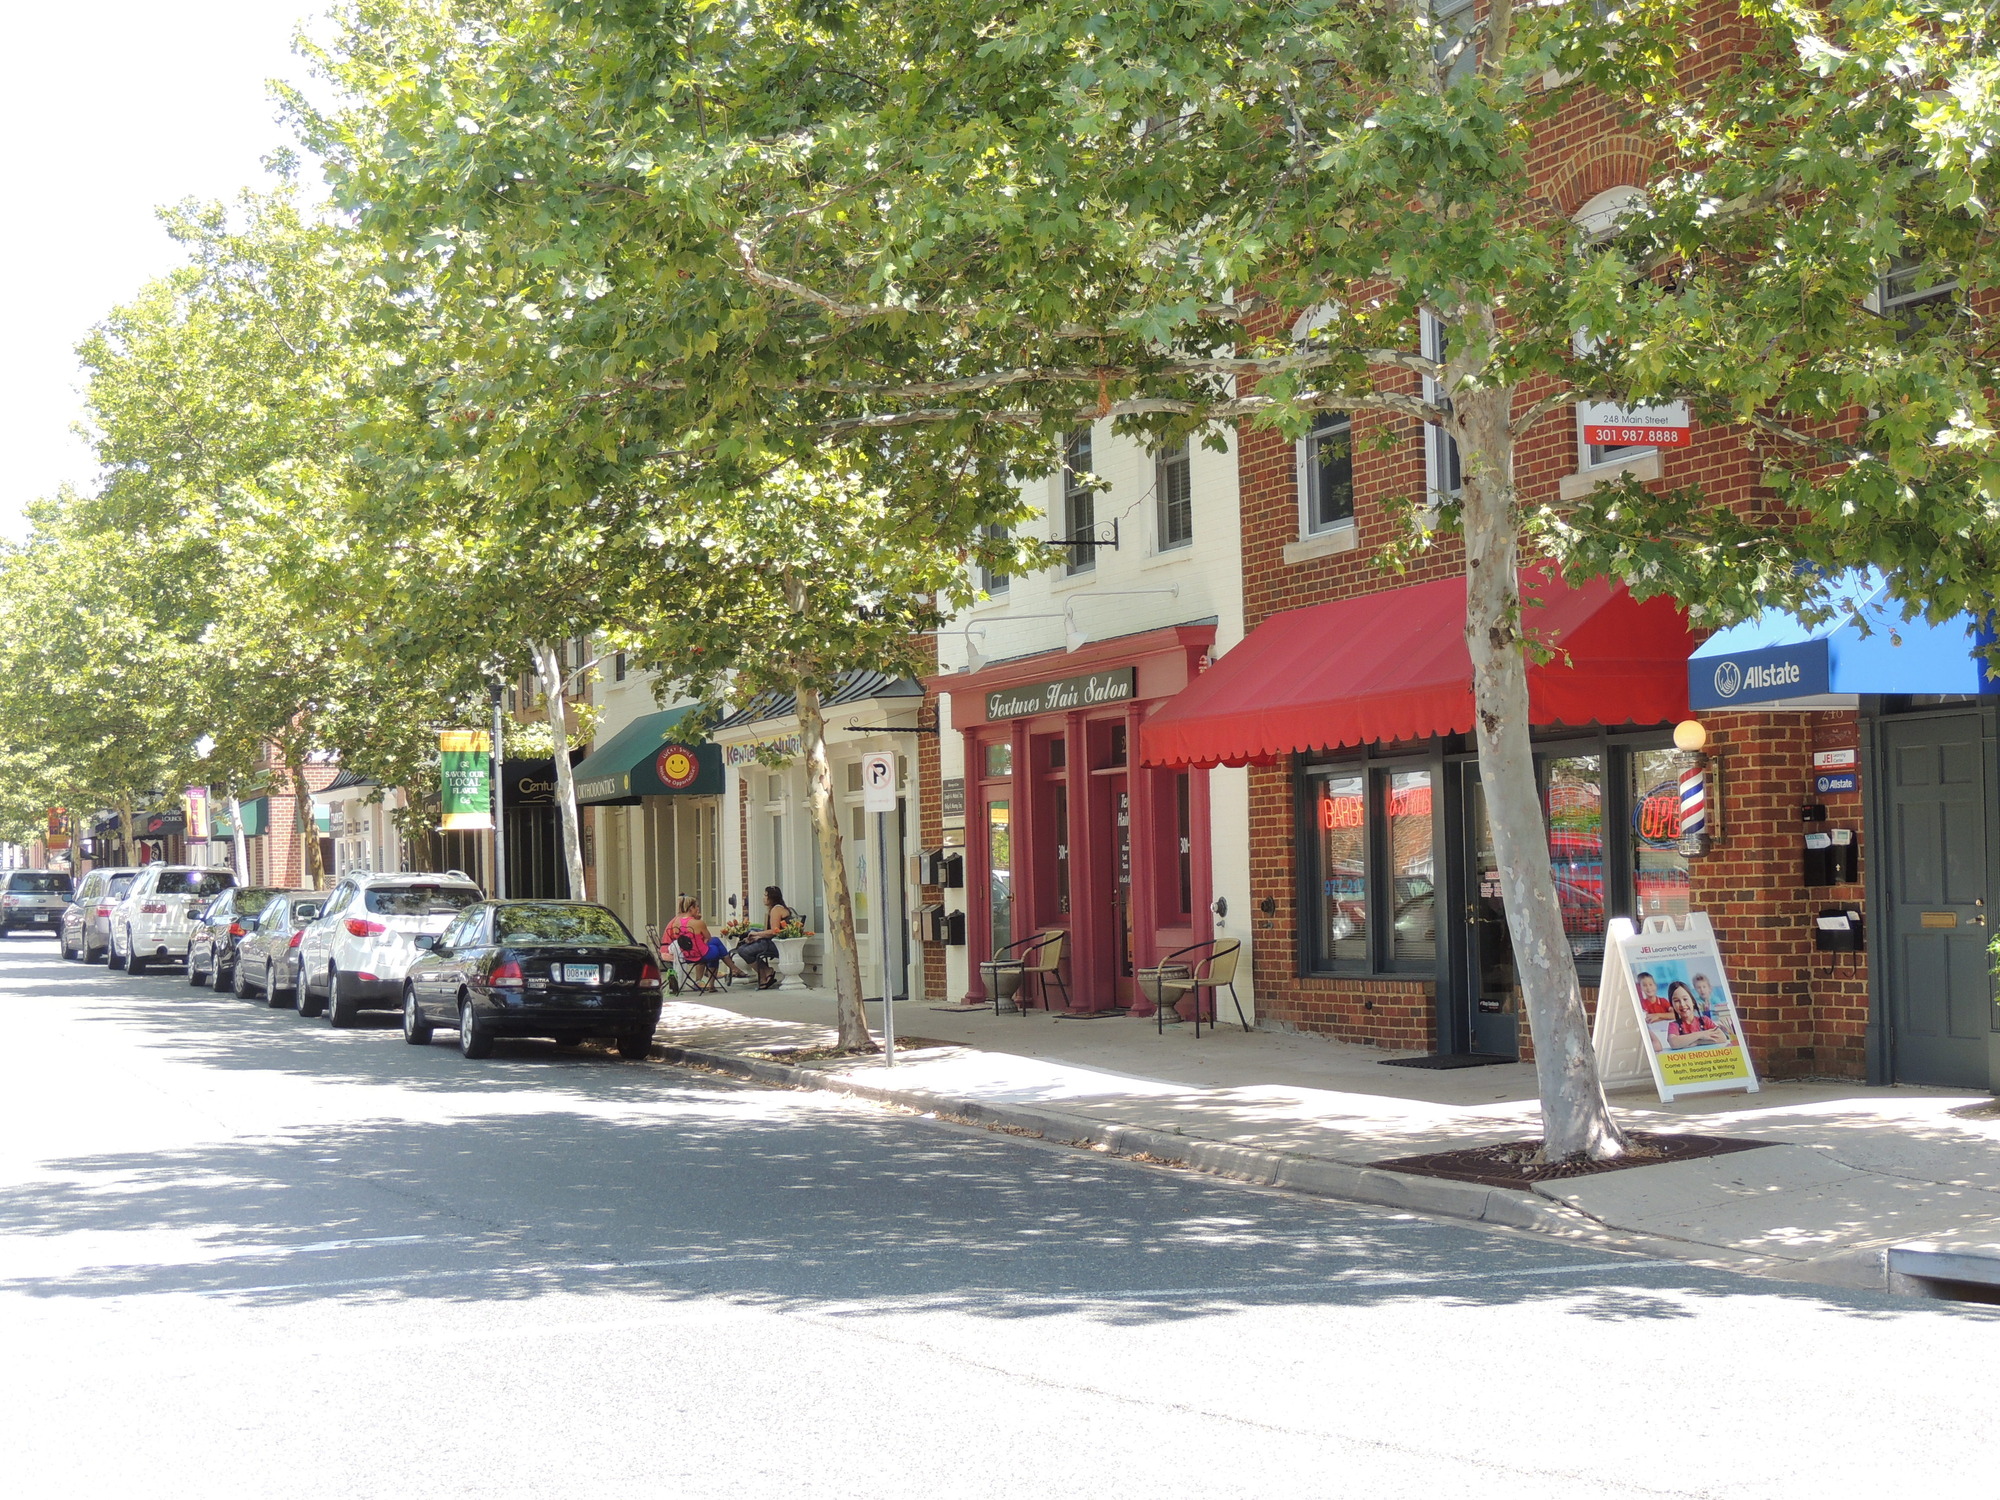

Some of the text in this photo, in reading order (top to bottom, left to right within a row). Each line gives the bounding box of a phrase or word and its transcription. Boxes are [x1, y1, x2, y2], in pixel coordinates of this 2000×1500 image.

[1603, 415, 1669, 424] 248 Main Street
[1595, 429, 1679, 443] 301.987.8888
[1743, 661, 1800, 690] Allstate
[988, 676, 1129, 719] Textures Hair Salon
[1822, 753, 1833, 763] JEI
[445, 770, 485, 778] SAVOR OUR
[449, 777, 482, 787] LOCAL
[518, 777, 554, 794] Centu
[1829, 779, 1853, 789] Allstate
[452, 787, 478, 795] FLAVOR
[576, 778, 616, 800] ORTHODONTICS
[1324, 795, 1364, 829] BARBE
[1641, 796, 1680, 838] OPE
[1640, 946, 1652, 954] JEI
[1651, 945, 1677, 953] Learning
[1667, 1048, 1733, 1062] NOW ENROLLING!
[1678, 1071, 1734, 1081] enrichment programs
